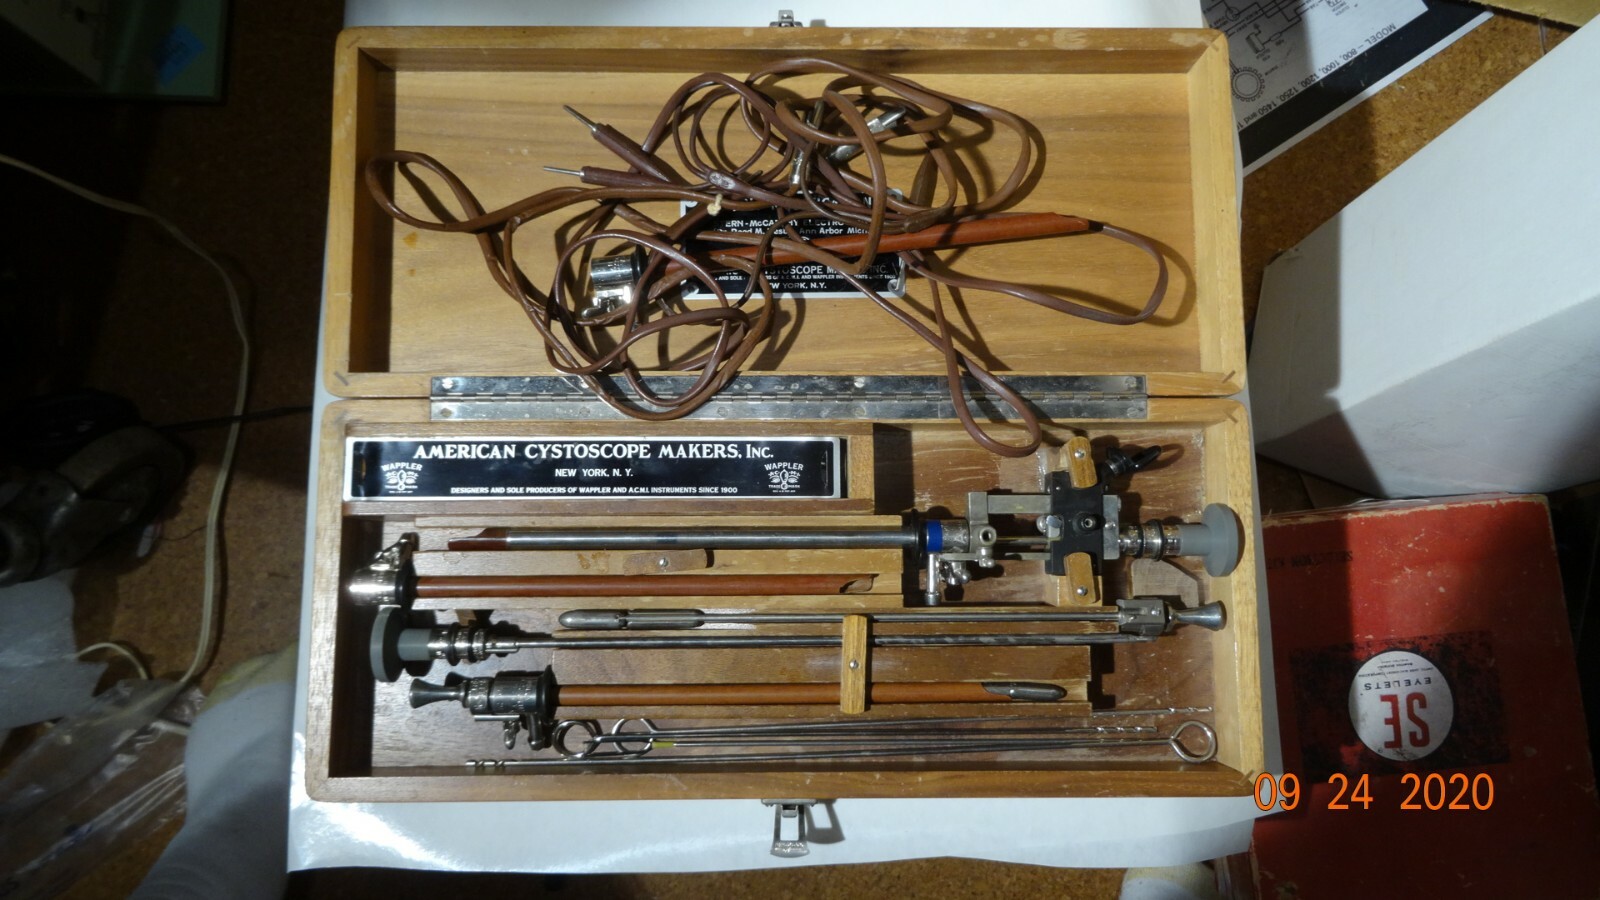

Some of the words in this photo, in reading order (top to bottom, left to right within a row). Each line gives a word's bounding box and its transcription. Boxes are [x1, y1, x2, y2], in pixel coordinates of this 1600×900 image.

[1364, 22, 1397, 46] MODEL
[1339, 48, 1358, 61] 800,
[1318, 60, 1340, 75] 1000,
[1298, 73, 1320, 88] 1200,
[1276, 86, 1299, 102] 1250,
[1258, 101, 1277, 115] 1450
[1243, 112, 1258, 124] and
[819, 227, 844, 235] Arbor
[783, 282, 808, 290] YORK,
[413, 443, 516, 459] AMERICAN
[524, 443, 651, 459] CYSTOSCOPE
[658, 443, 742, 460] MAKERS,
[381, 461, 423, 471] WAPPLER
[555, 468, 577, 477] NEW
[582, 468, 610, 478] YORK,
[764, 461, 804, 471] WAPPLER
[1364, 677, 1432, 691] EYELETS
[1380, 692, 1431, 749] SE
